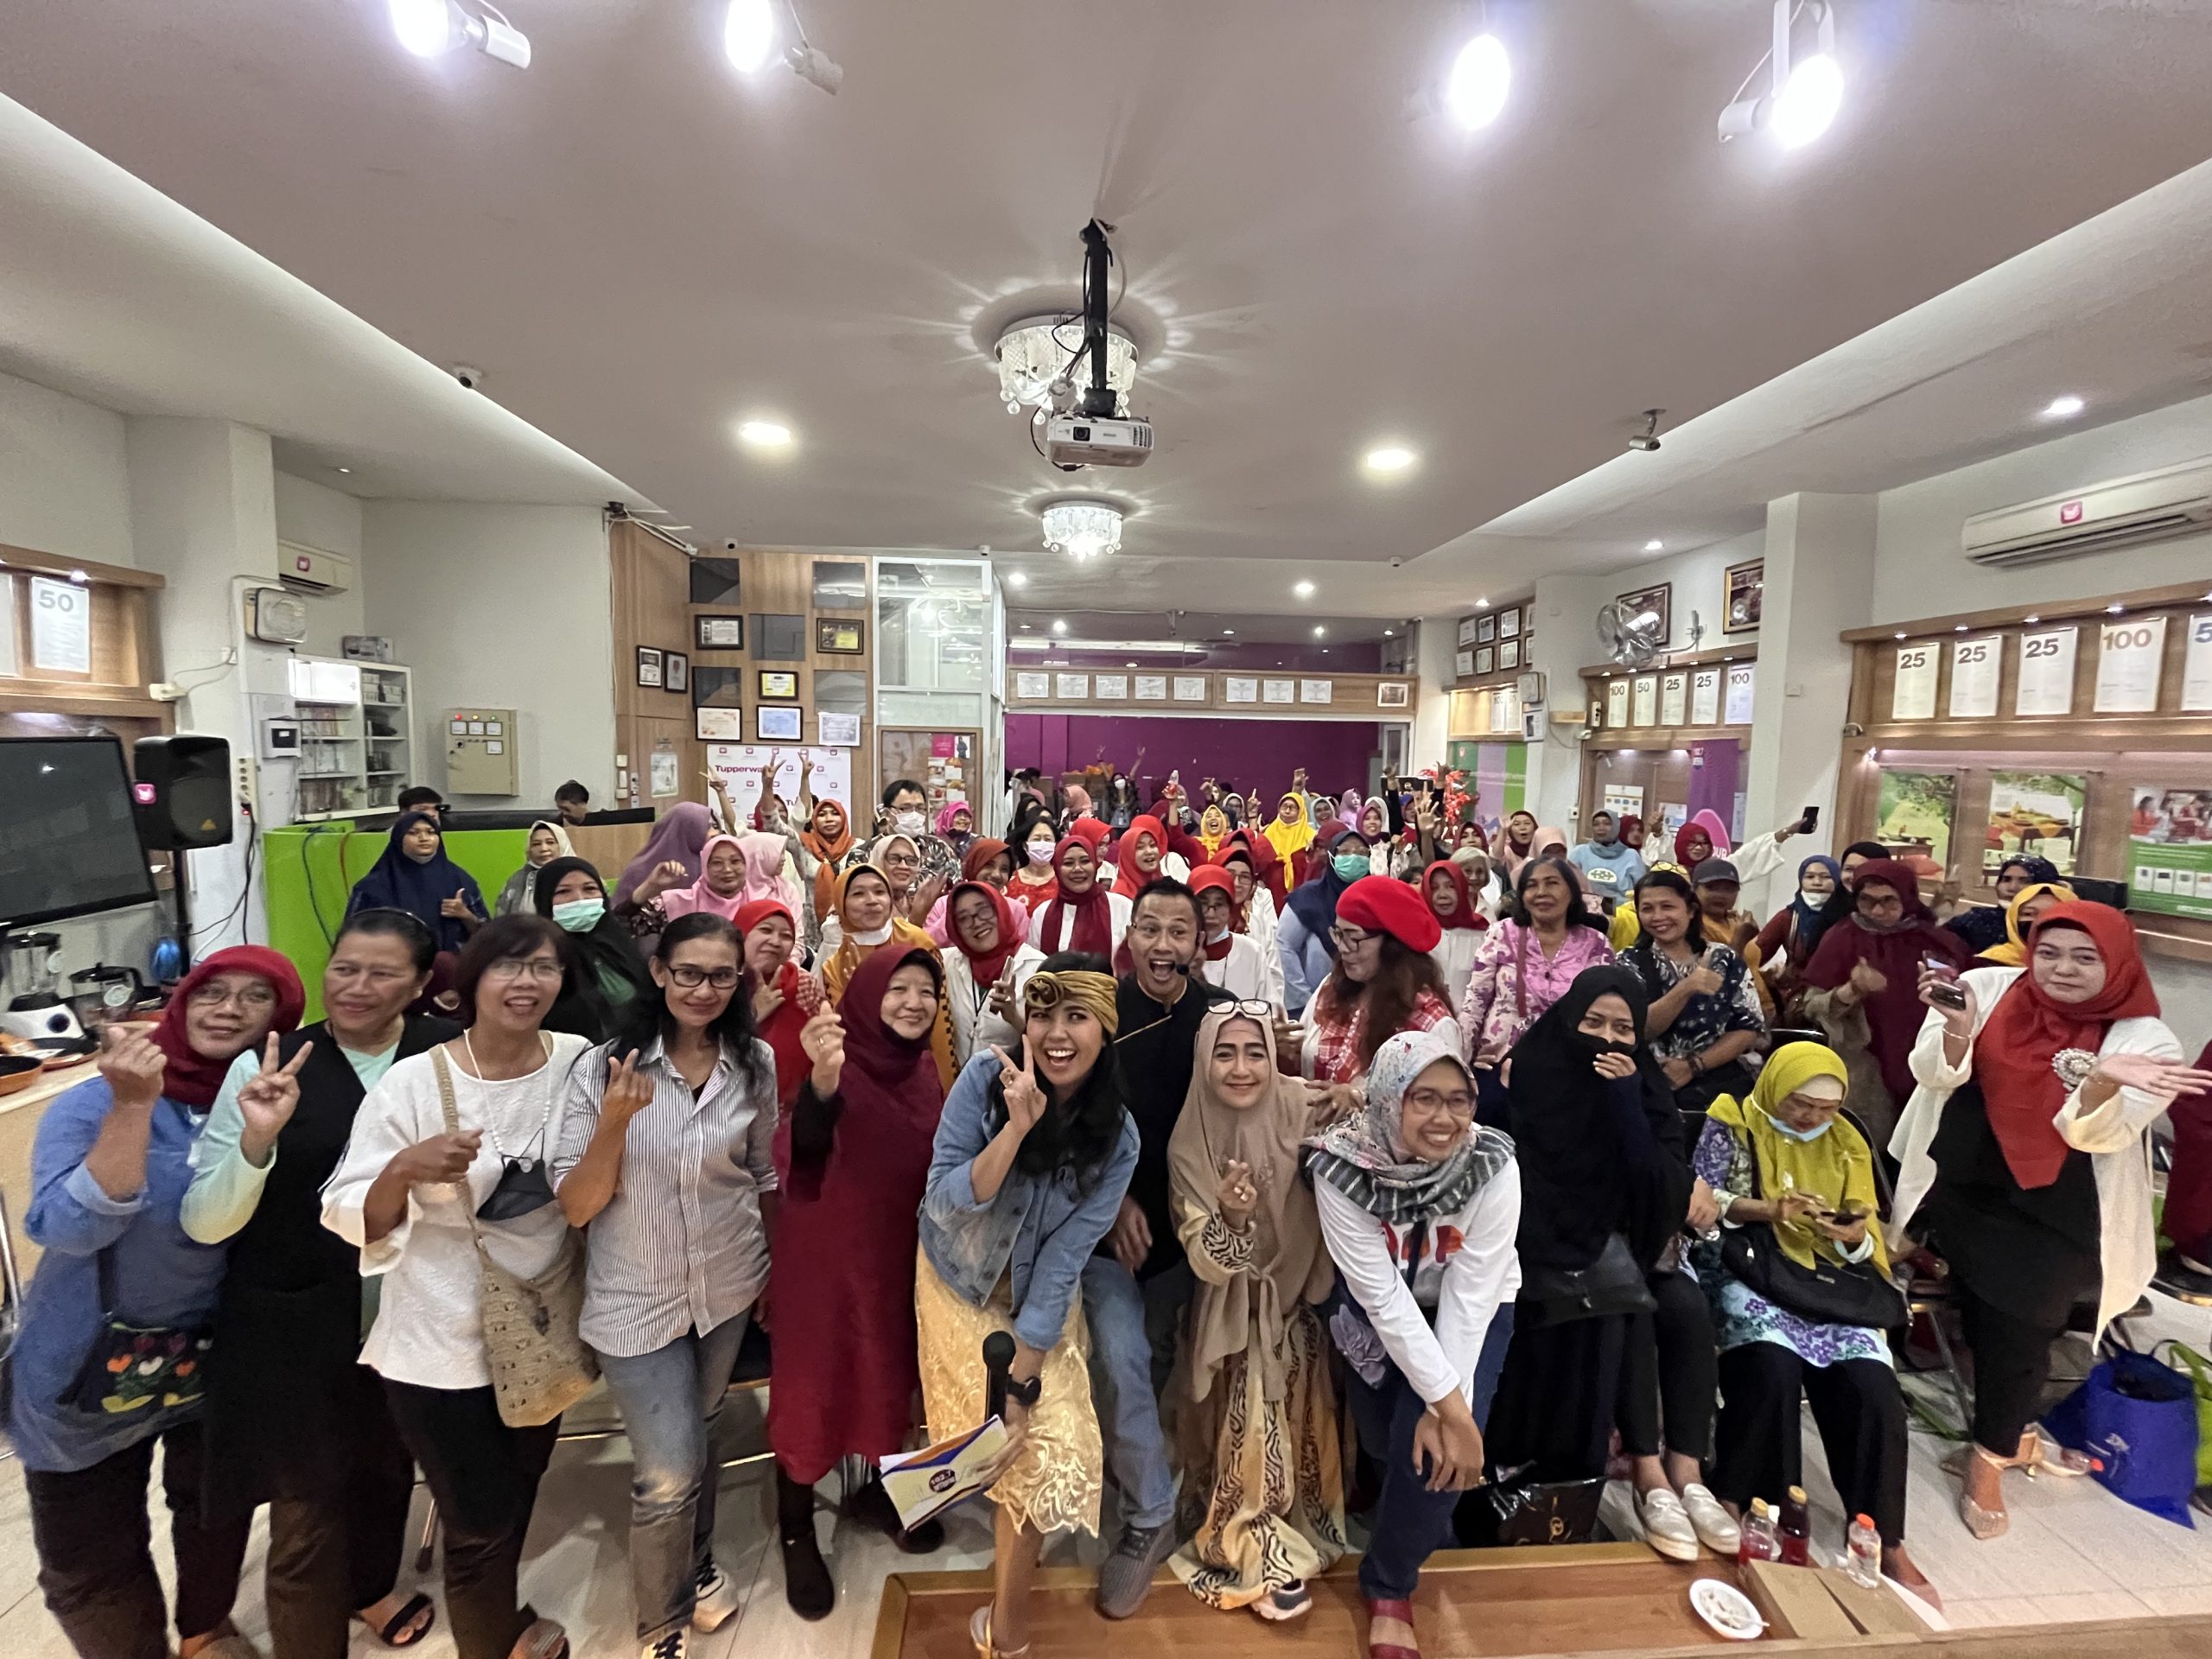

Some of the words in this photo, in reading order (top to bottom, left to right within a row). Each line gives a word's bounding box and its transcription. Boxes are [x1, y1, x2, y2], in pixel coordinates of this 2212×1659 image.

[38, 589, 74, 613] 50
[2102, 628, 2152, 651] 100
[2195, 622, 2212, 644] 5
[1957, 645, 1986, 664] 25
[2024, 638, 2059, 658] 25
[1900, 652, 1926, 670] 25
[1666, 678, 1680, 690] 25
[1696, 676, 1712, 688] 25
[1730, 672, 1750, 685] 100
[1610, 685, 1625, 696] 100
[1637, 682, 1649, 693] 50
[715, 765, 764, 773] Tupperwa
